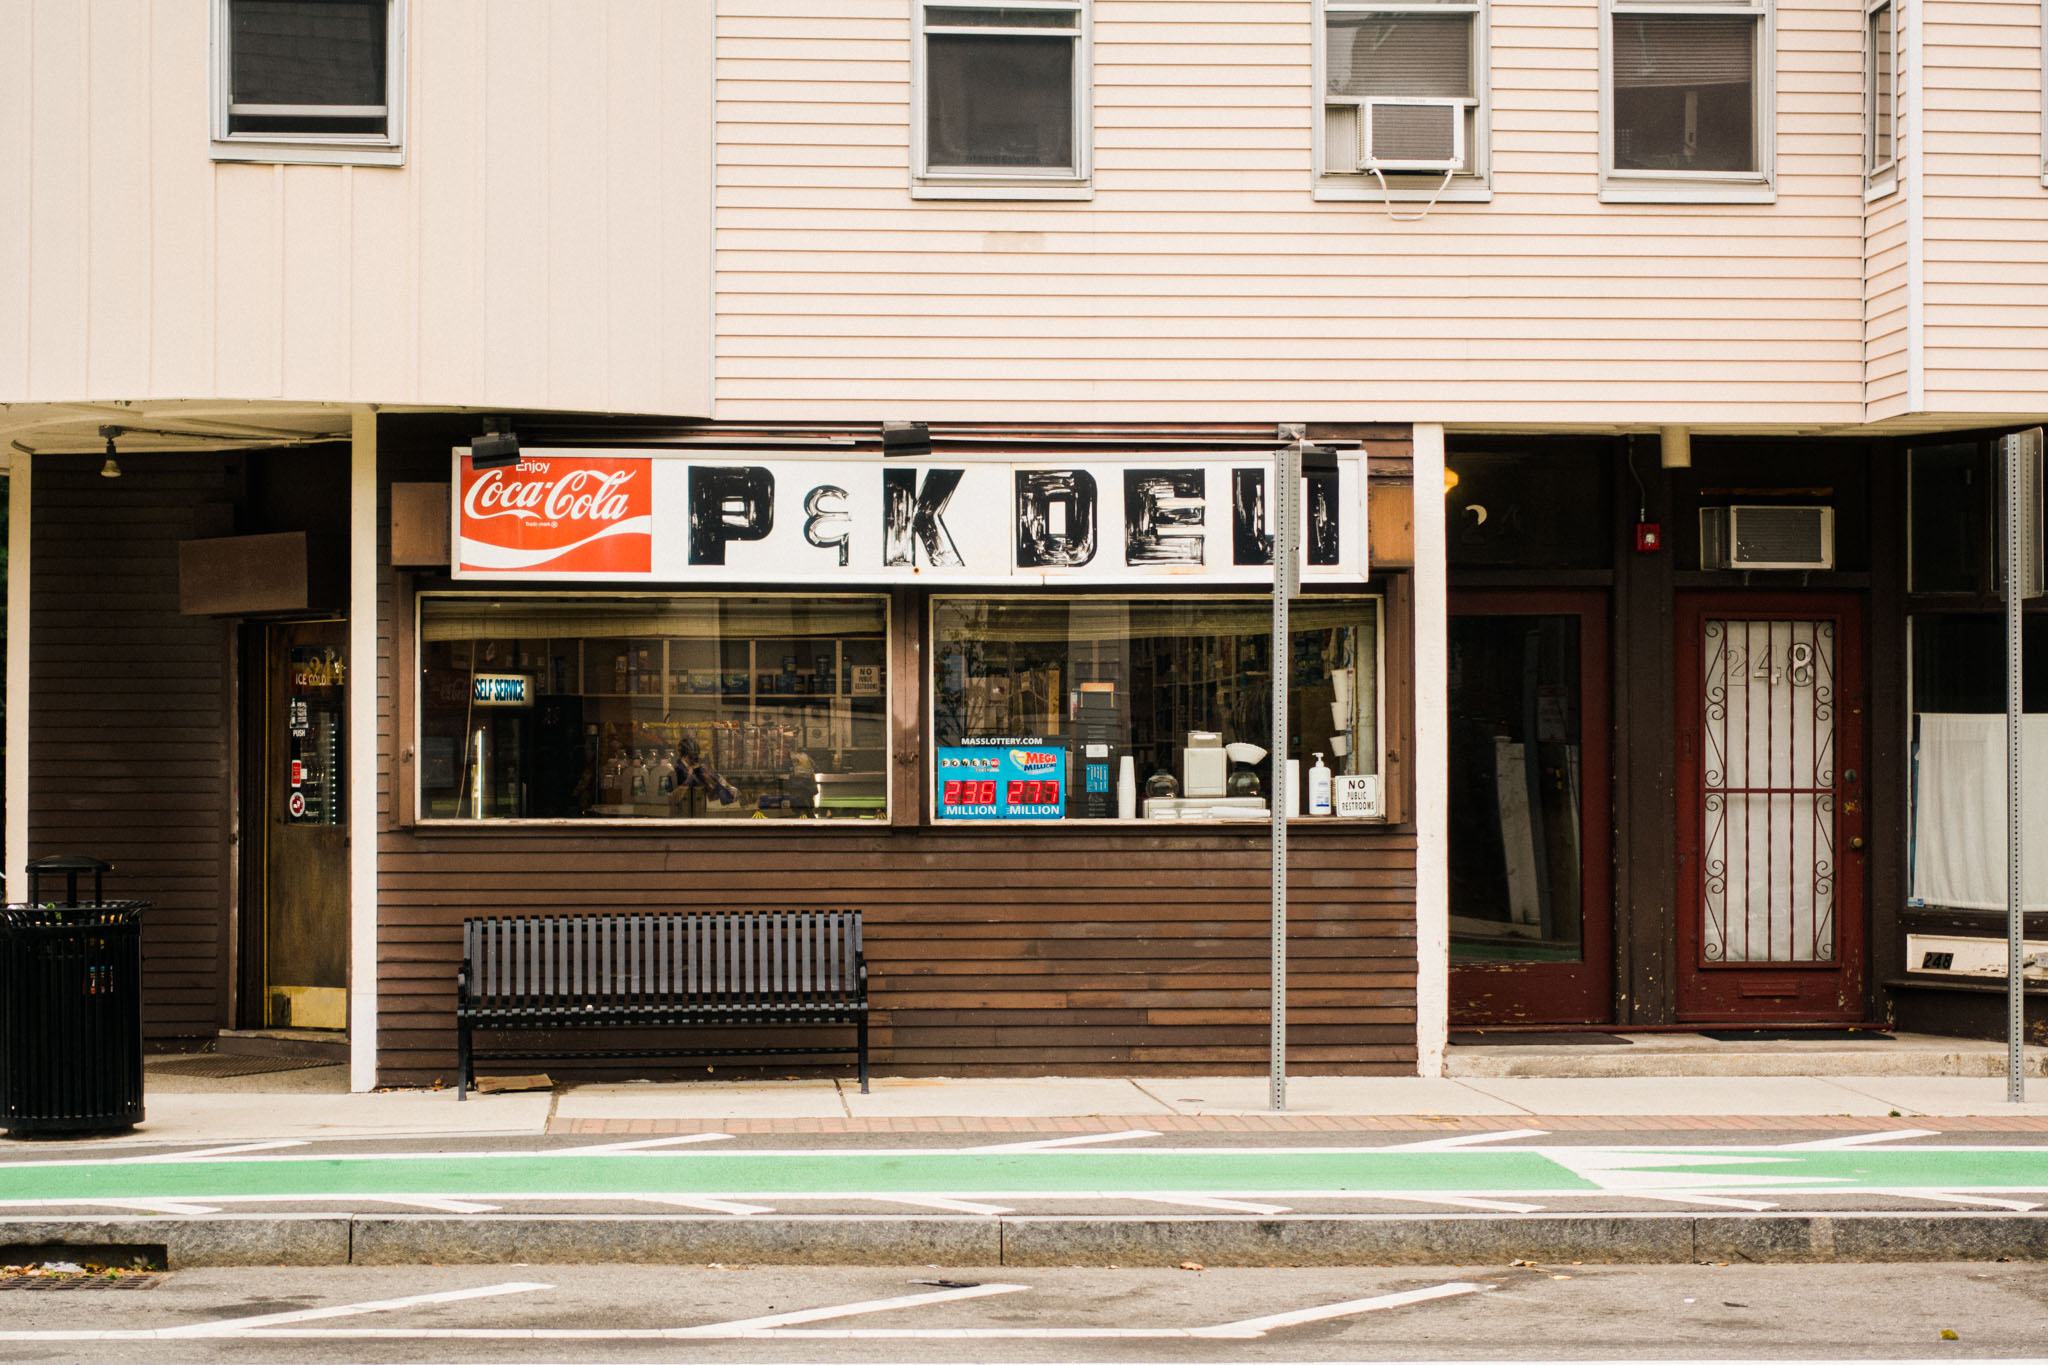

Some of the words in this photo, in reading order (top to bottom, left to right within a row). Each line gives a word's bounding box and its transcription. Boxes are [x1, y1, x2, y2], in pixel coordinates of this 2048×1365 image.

[515, 460, 551, 474] Enjoy
[464, 469, 637, 520] Coca-Cola
[1014, 468, 1341, 568] DELI
[1719, 642, 1815, 688] 248
[295, 673, 307, 685] ICE
[474, 678, 493, 701] SELF
[494, 678, 525, 702] SERVICE
[292, 729, 306, 737] PUSH
[961, 737, 1043, 745] MASSLOTTERY.COM
[940, 758, 1000, 768] POWER
[1024, 751, 1057, 764] MEGA
[1348, 779, 1366, 789] NO
[943, 780, 997, 805] 238
[1006, 780, 1060, 805] 277
[1347, 791, 1366, 800] PUBLIC
[946, 805, 997, 815] MILLION
[1009, 805, 1060, 815] MILLION
[1341, 801, 1375, 811] RESTROOMS
[1922, 951, 1953, 970] 248
